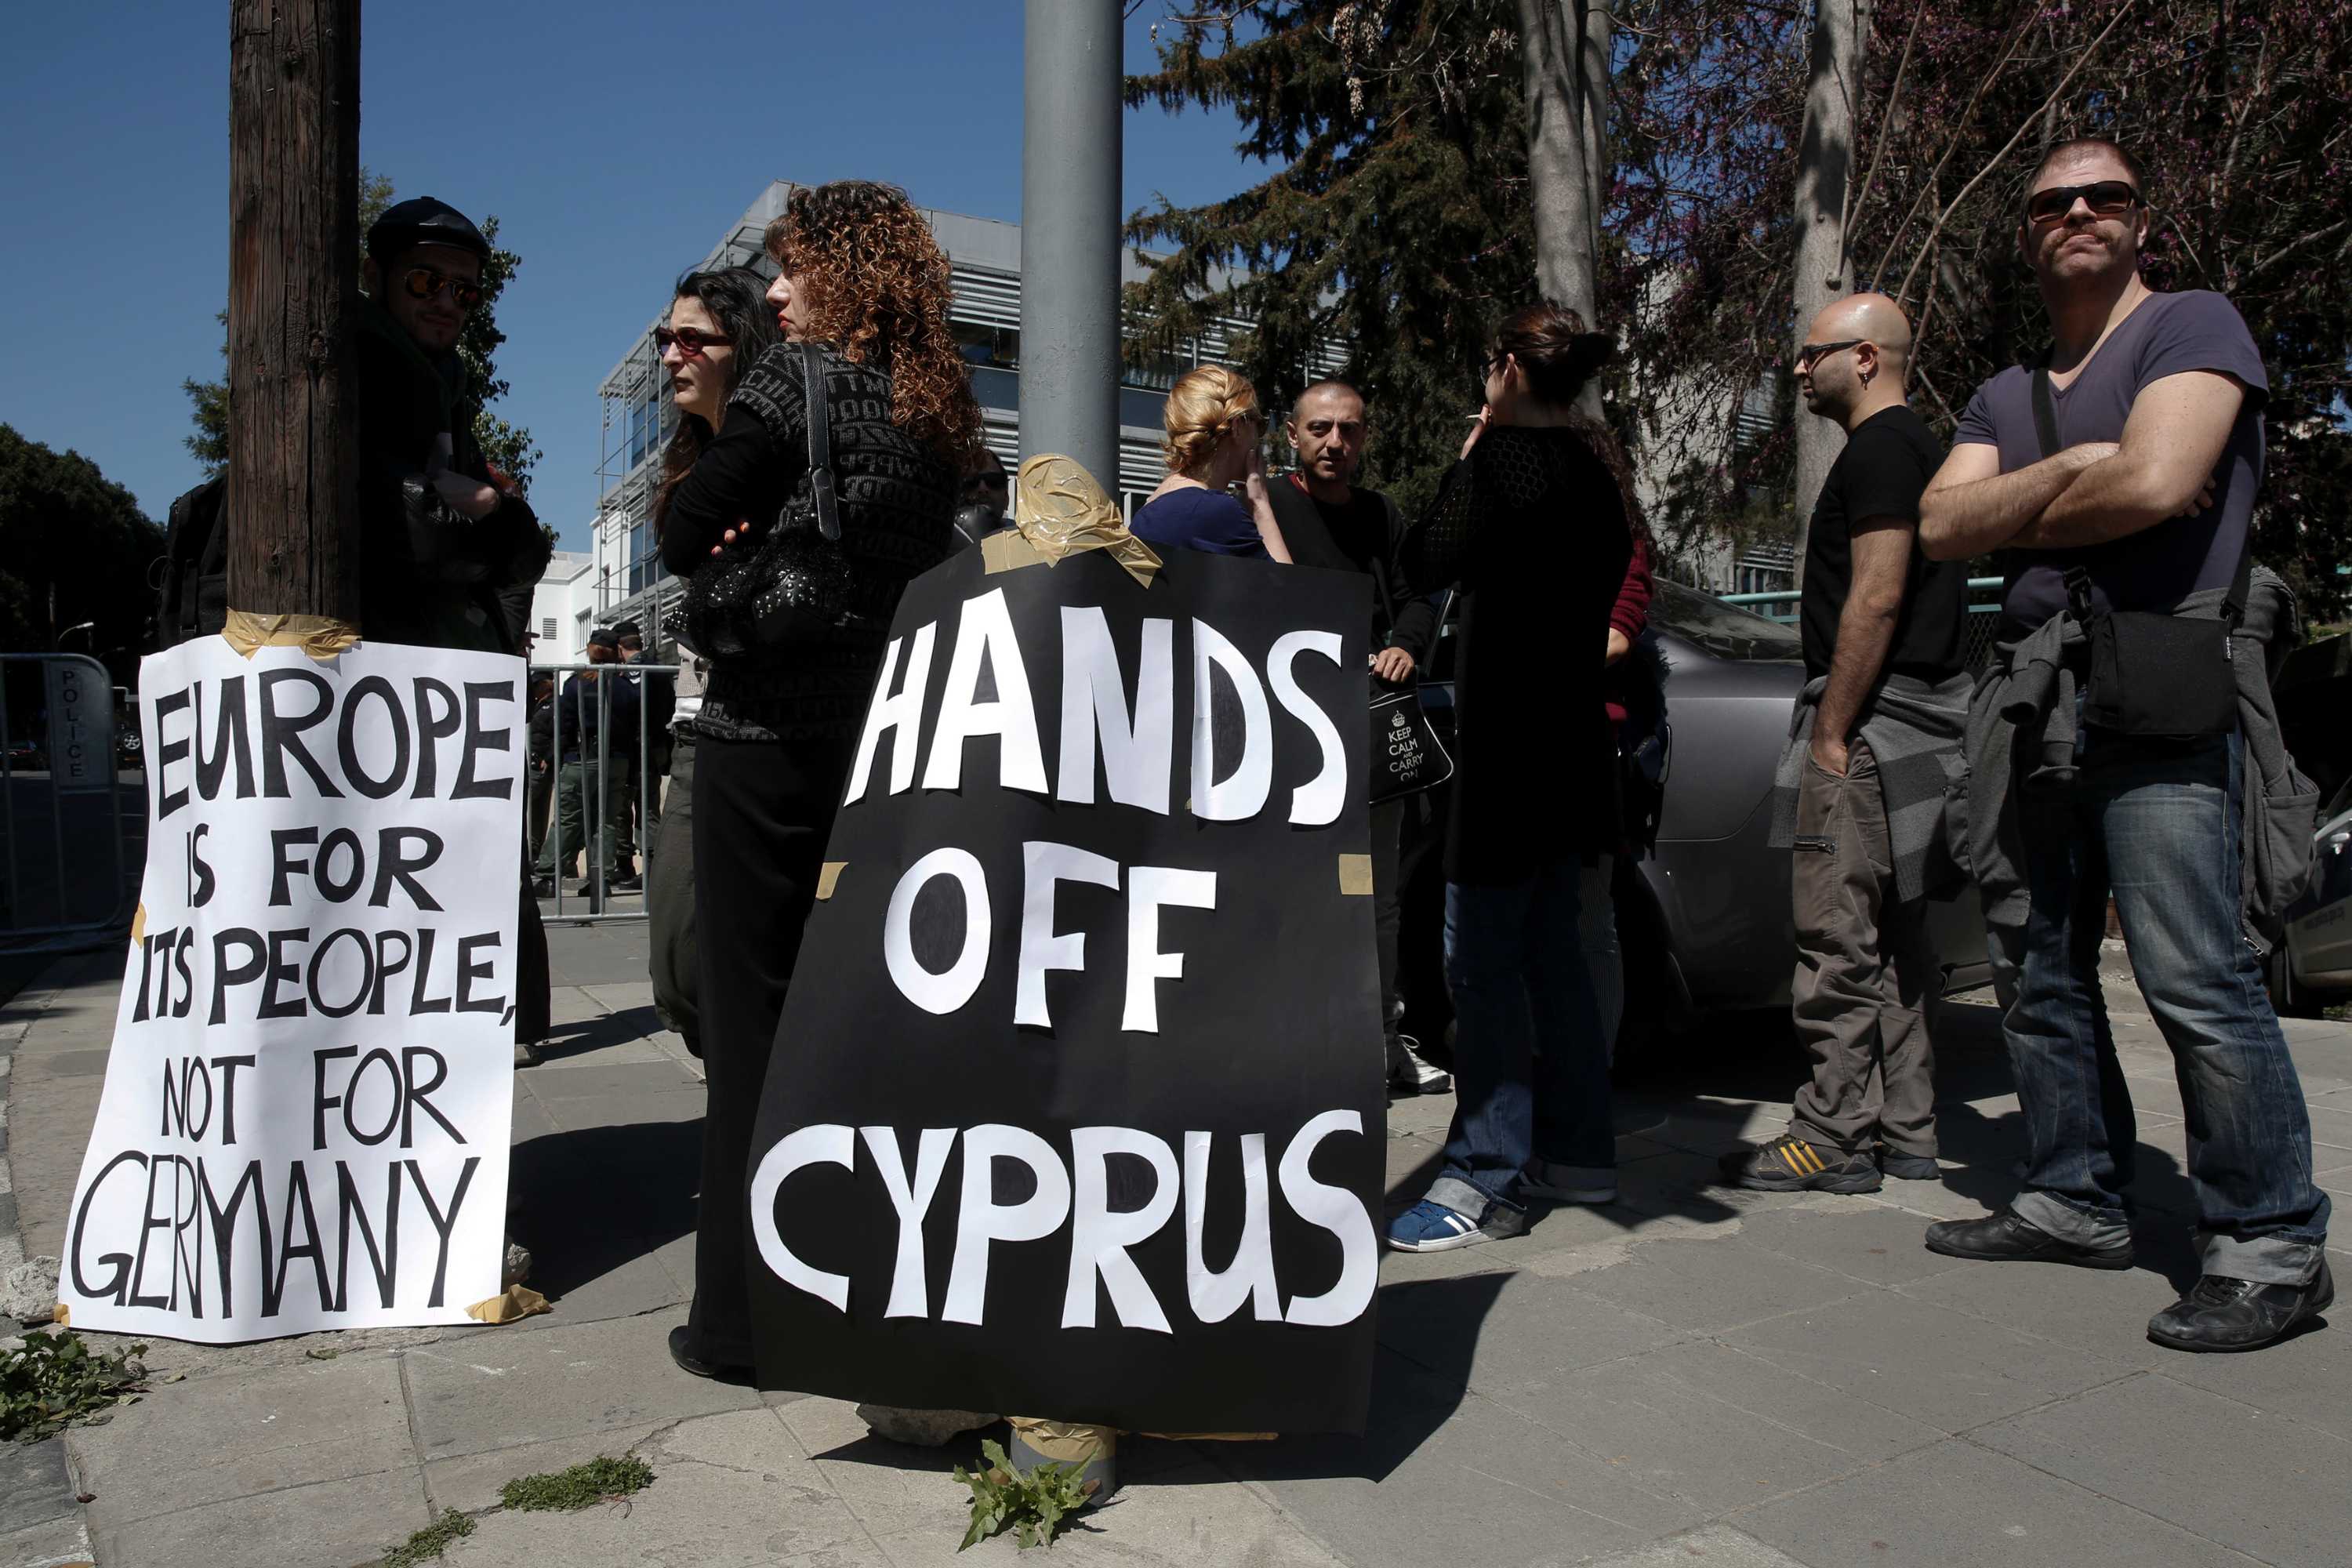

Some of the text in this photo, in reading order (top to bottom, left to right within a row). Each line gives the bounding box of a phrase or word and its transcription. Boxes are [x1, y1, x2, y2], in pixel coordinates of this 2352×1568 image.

[63, 670, 83, 777] POLICE
[156, 668, 514, 822] EUROPE
[844, 587, 1347, 825] HANDS
[1388, 726, 1411, 742] KEEP
[1388, 738, 1417, 756] CALM
[1389, 753, 1423, 772] CARRY
[186, 823, 444, 911] IS FOR
[132, 927, 516, 1027] ITS PEOPLE,
[884, 841, 1217, 1033] OFF
[162, 1045, 466, 1150] NOT FOR
[71, 1151, 481, 1319] GERMANY
[751, 1109, 1377, 1334] CYPRUS
